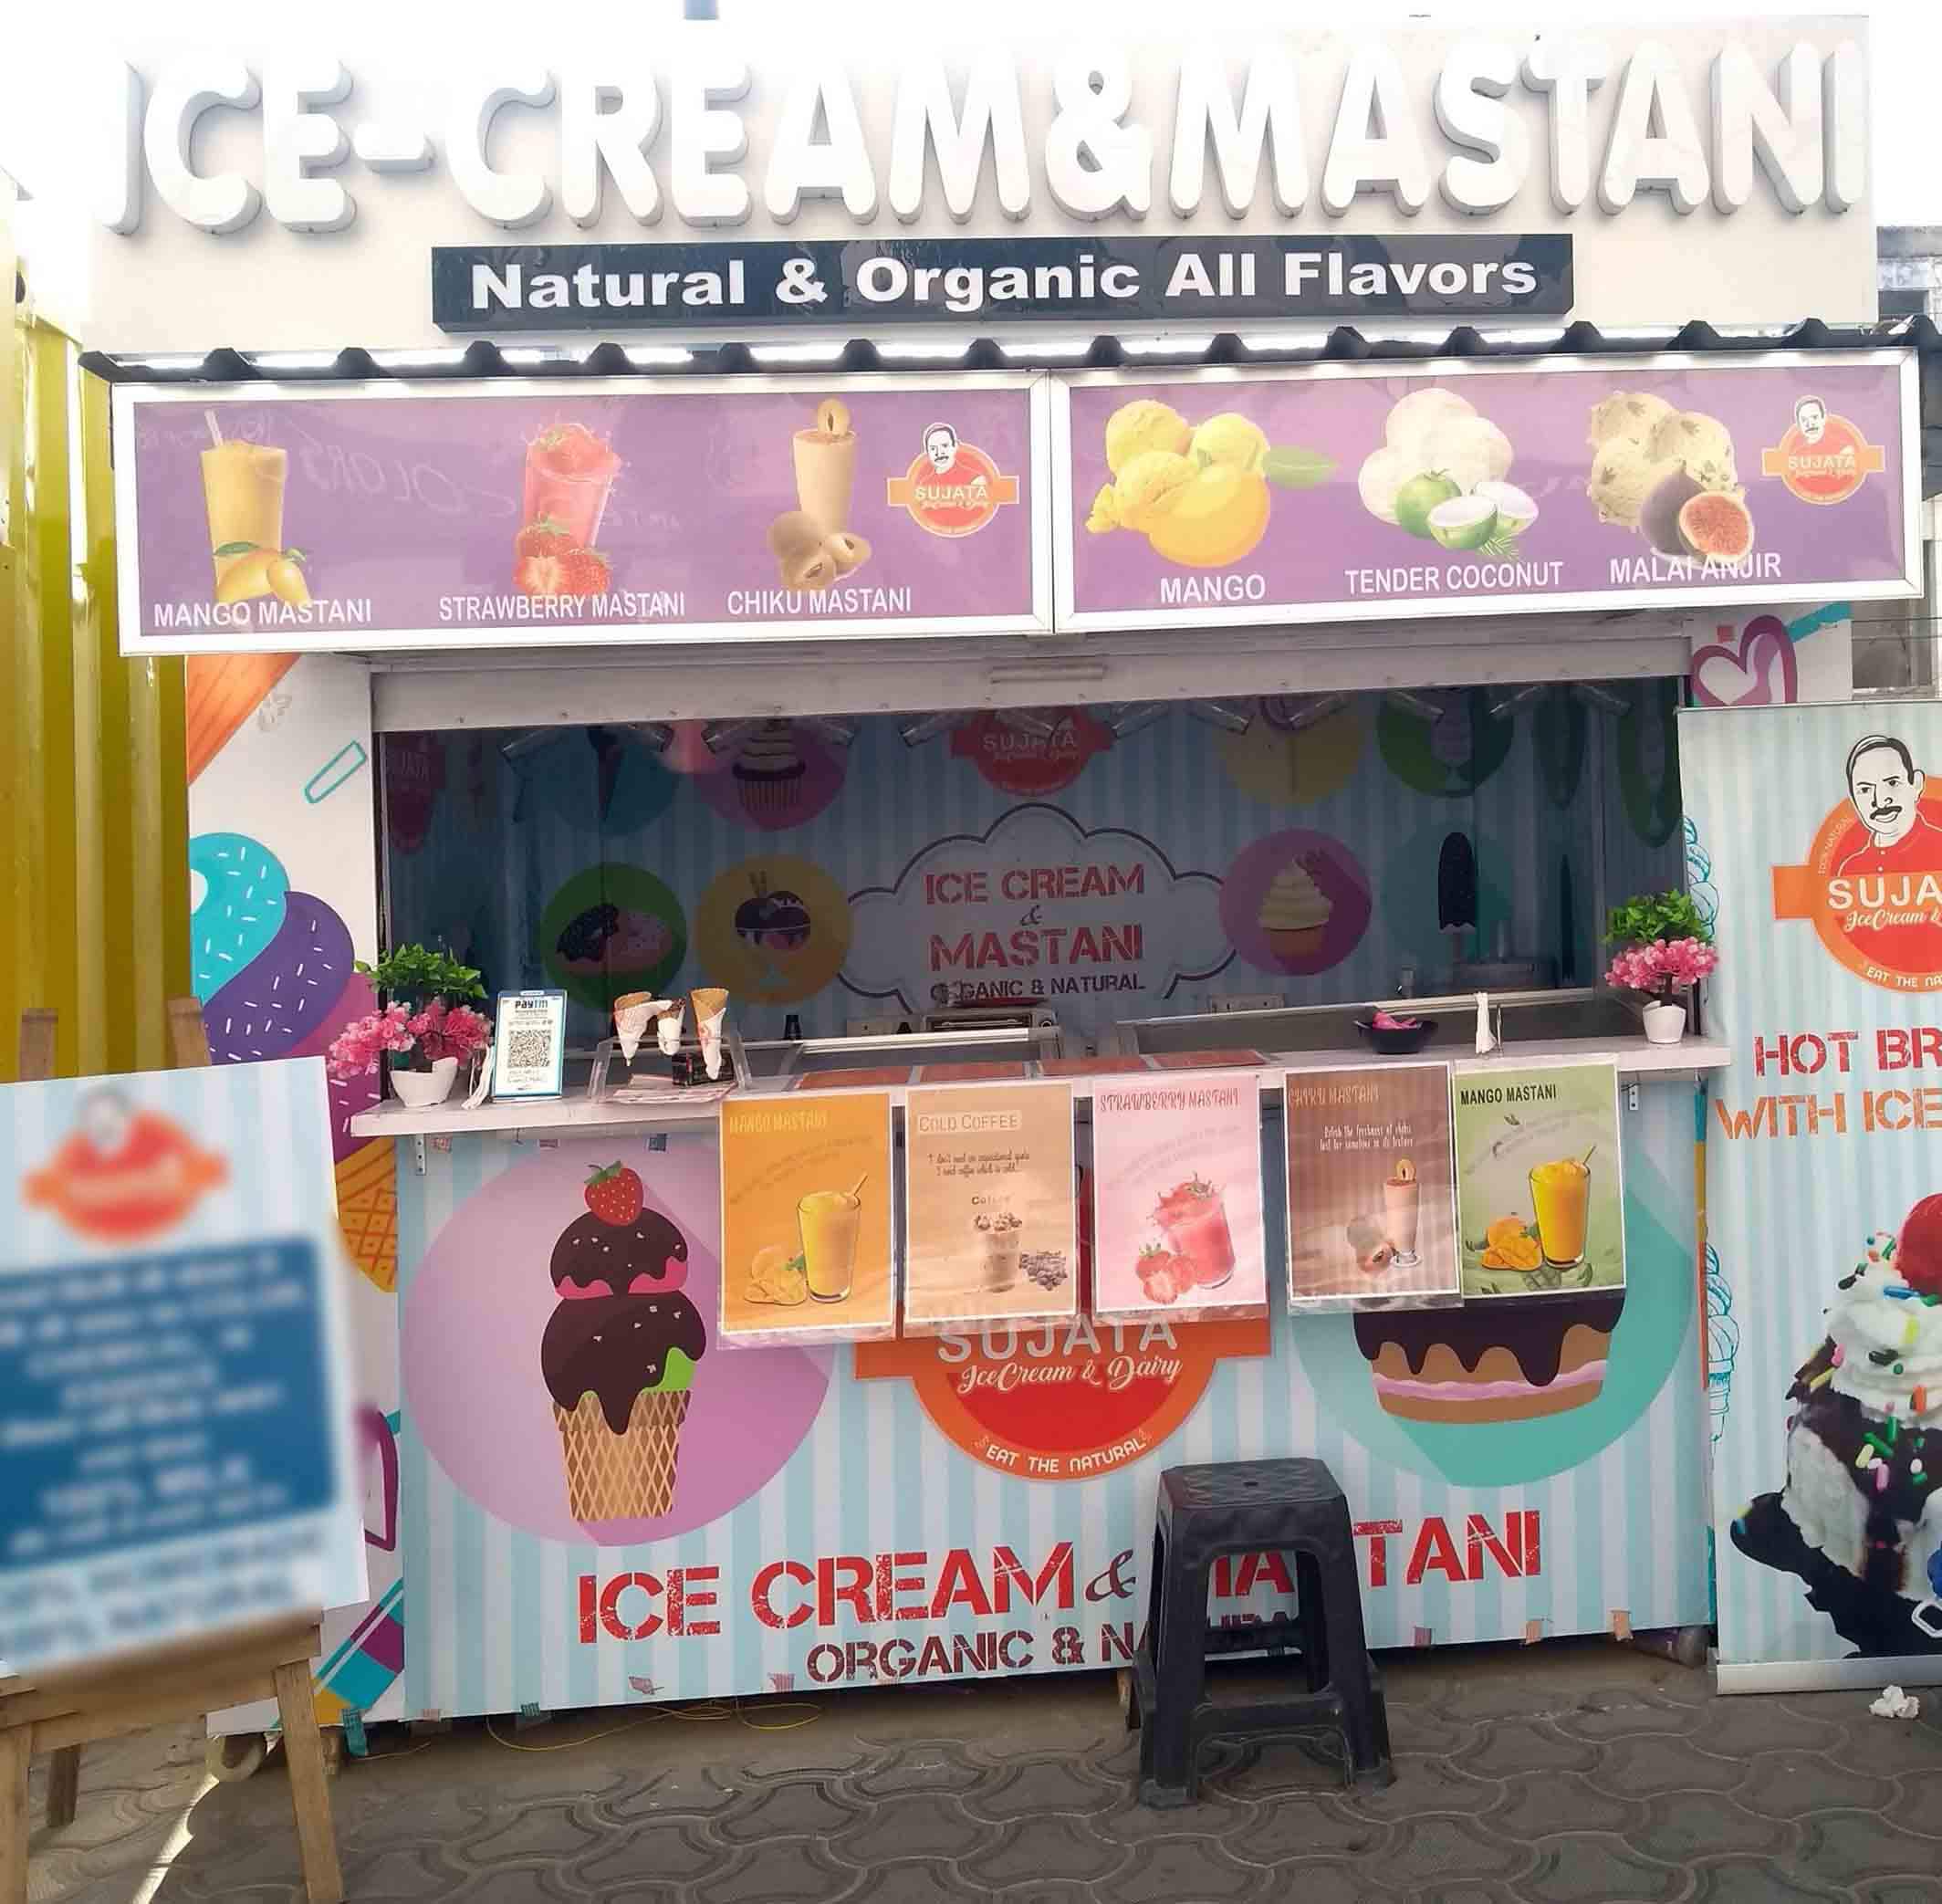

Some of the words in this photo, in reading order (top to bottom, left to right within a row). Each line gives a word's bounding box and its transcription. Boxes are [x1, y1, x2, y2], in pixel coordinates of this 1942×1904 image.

[472, 259, 745, 309] Natural
[776, 258, 829, 305] &
[856, 254, 1141, 313] Organic
[1164, 253, 1257, 298] All
[1283, 252, 1539, 298] Flavors
[914, 484, 987, 501] SUJATA
[1344, 566, 1440, 594] TENDER
[1446, 560, 1565, 590] COCONUT
[1609, 556, 1693, 585] MALAI
[1699, 552, 1782, 583] ANJIR
[727, 589, 802, 616] CHIKU
[809, 587, 912, 614] MASTANI
[1160, 574, 1266, 603] MANGO
[153, 601, 252, 628] MANGO
[258, 597, 371, 625] MASTANI
[438, 593, 586, 622] STRAWBERRY
[592, 591, 685, 618] MASTANI
[924, 869, 989, 905] ICE
[1001, 863, 1145, 902] CREAM
[1018, 905, 1043, 927] &
[928, 924, 1143, 972] MASTANI
[1030, 978, 1045, 996] &
[1050, 972, 1146, 995] NATURAL
[1866, 966, 1890, 987] EAT
[1896, 975, 1918, 988] THE
[1752, 1030, 1860, 1077] HOT
[1876, 1026, 1942, 1072] BR
[1101, 1091, 1185, 1112] STRAWBERRY
[1459, 1087, 1503, 1105] MANGO
[1506, 1083, 1557, 1103] MASTANI
[919, 1115, 957, 1133] COLD
[962, 1114, 1018, 1130] COFFEE
[1715, 1091, 1847, 1141] WITH
[1863, 1086, 1942, 1133] ICE
[956, 1361, 1074, 1395] IceCream
[1081, 1357, 1102, 1386] &
[1107, 1355, 1184, 1391] Dairy
[986, 1444, 1019, 1468] EAT
[1028, 1456, 1060, 1473] THE
[1069, 1438, 1147, 1473] NATURAL
[578, 1564, 722, 1645] ICE
[750, 1540, 1076, 1630] CREAM
[1084, 1548, 1137, 1604] &
[1214, 1509, 1541, 1599] ATANI
[806, 1628, 1035, 1684] ORGANIC
[1050, 1626, 1085, 1667] &
